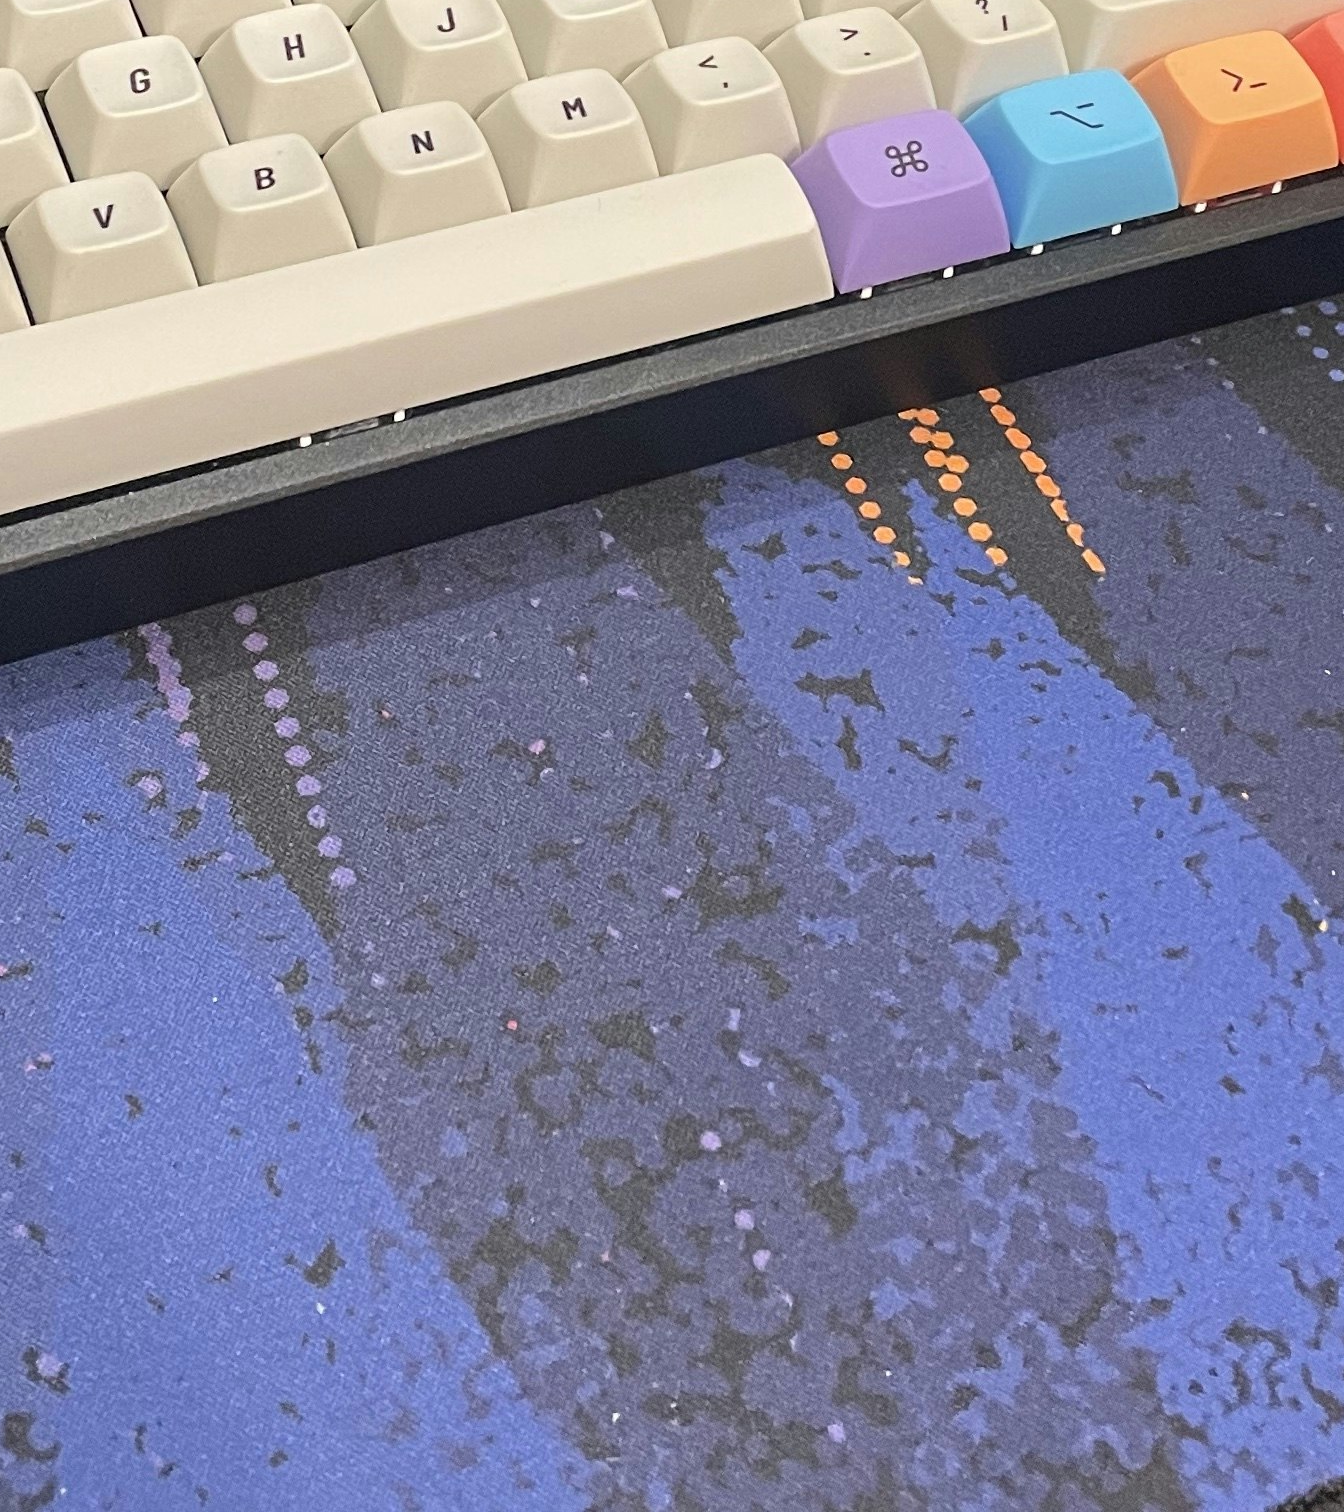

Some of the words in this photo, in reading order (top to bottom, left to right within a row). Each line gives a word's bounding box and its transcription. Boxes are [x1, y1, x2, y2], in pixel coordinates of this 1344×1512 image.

[437, 7, 456, 33] J
[839, 28, 859, 41] >
[283, 33, 306, 62] H
[698, 55, 718, 69] <
[129, 68, 151, 94] G
[561, 97, 587, 121] M
[410, 130, 435, 155] N
[254, 167, 276, 191] B
[92, 204, 114, 229] V
